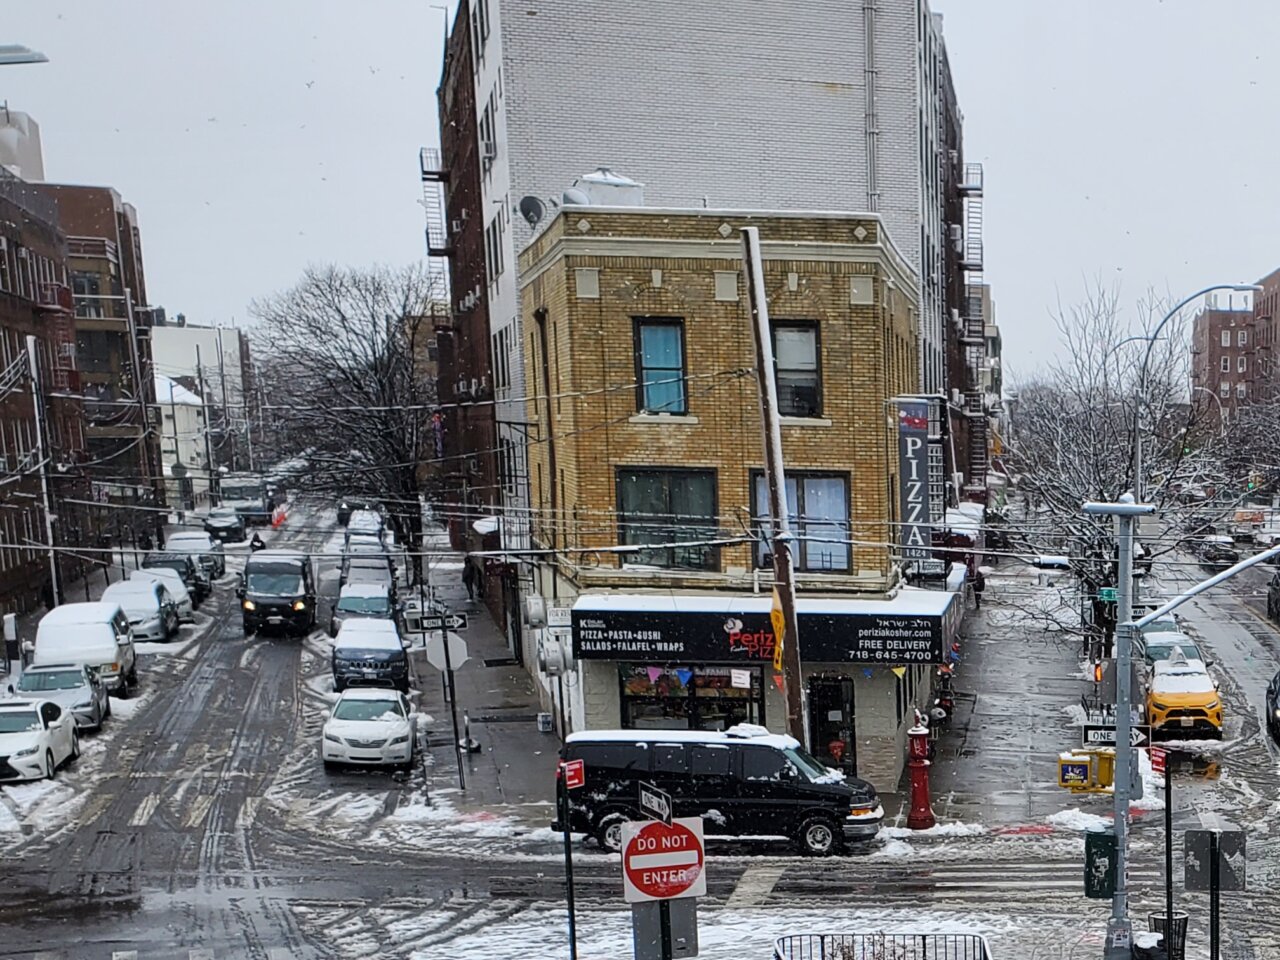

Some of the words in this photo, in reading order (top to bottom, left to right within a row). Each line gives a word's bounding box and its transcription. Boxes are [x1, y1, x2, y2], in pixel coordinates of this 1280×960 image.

[905, 436, 925, 546] PIZZA
[580, 630, 603, 639] PIZZA
[608, 630, 633, 640] PASTA
[729, 630, 774, 646] Periz
[858, 627, 932, 638] periziakosher.com
[580, 641, 612, 651] SALADS
[617, 642, 651, 651] FALAFEL
[656, 642, 685, 652] WRAPS
[858, 640, 883, 649] FREE
[886, 640, 932, 650] DELIVERY
[848, 650, 932, 660] 718-645-4700
[1092, 732, 1113, 741] ONE
[644, 792, 655, 809] ONE
[637, 837, 657, 851] DO
[661, 834, 689, 849] NOT
[643, 870, 687, 885] ENTER
